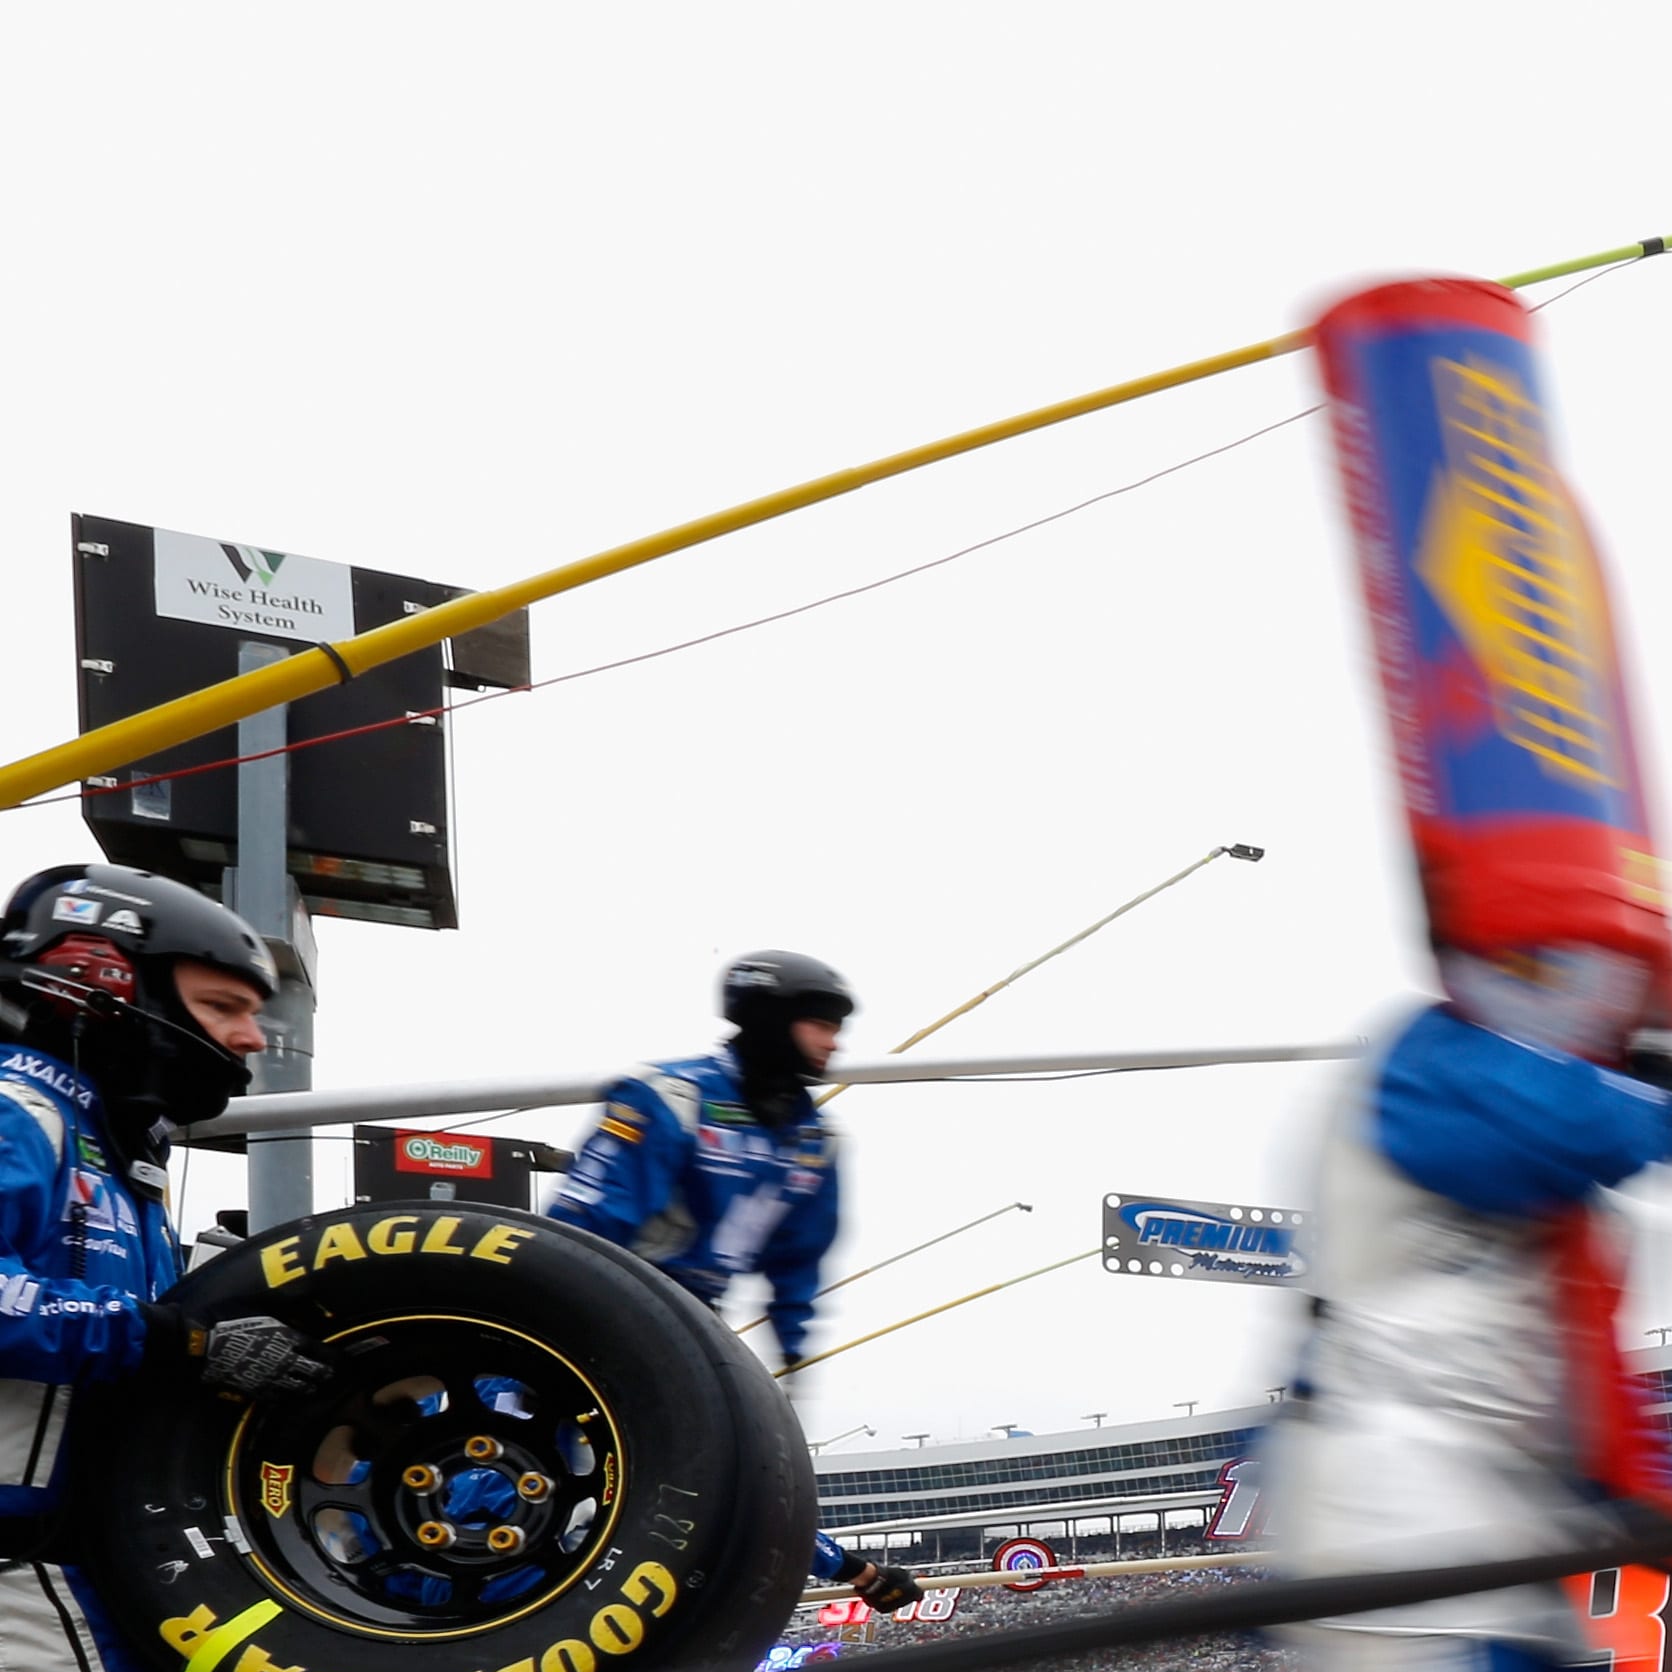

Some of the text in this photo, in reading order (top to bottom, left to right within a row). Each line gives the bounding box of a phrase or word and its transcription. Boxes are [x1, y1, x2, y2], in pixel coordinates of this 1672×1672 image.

[187, 578, 323, 615] Wise Health
[218, 604, 296, 630] System
[1, 1053, 95, 1110] AXALTA
[405, 1138, 482, 1167] O'Reilly
[260, 1215, 536, 1289] EAGLE
[268, 1468, 283, 1507] AERO
